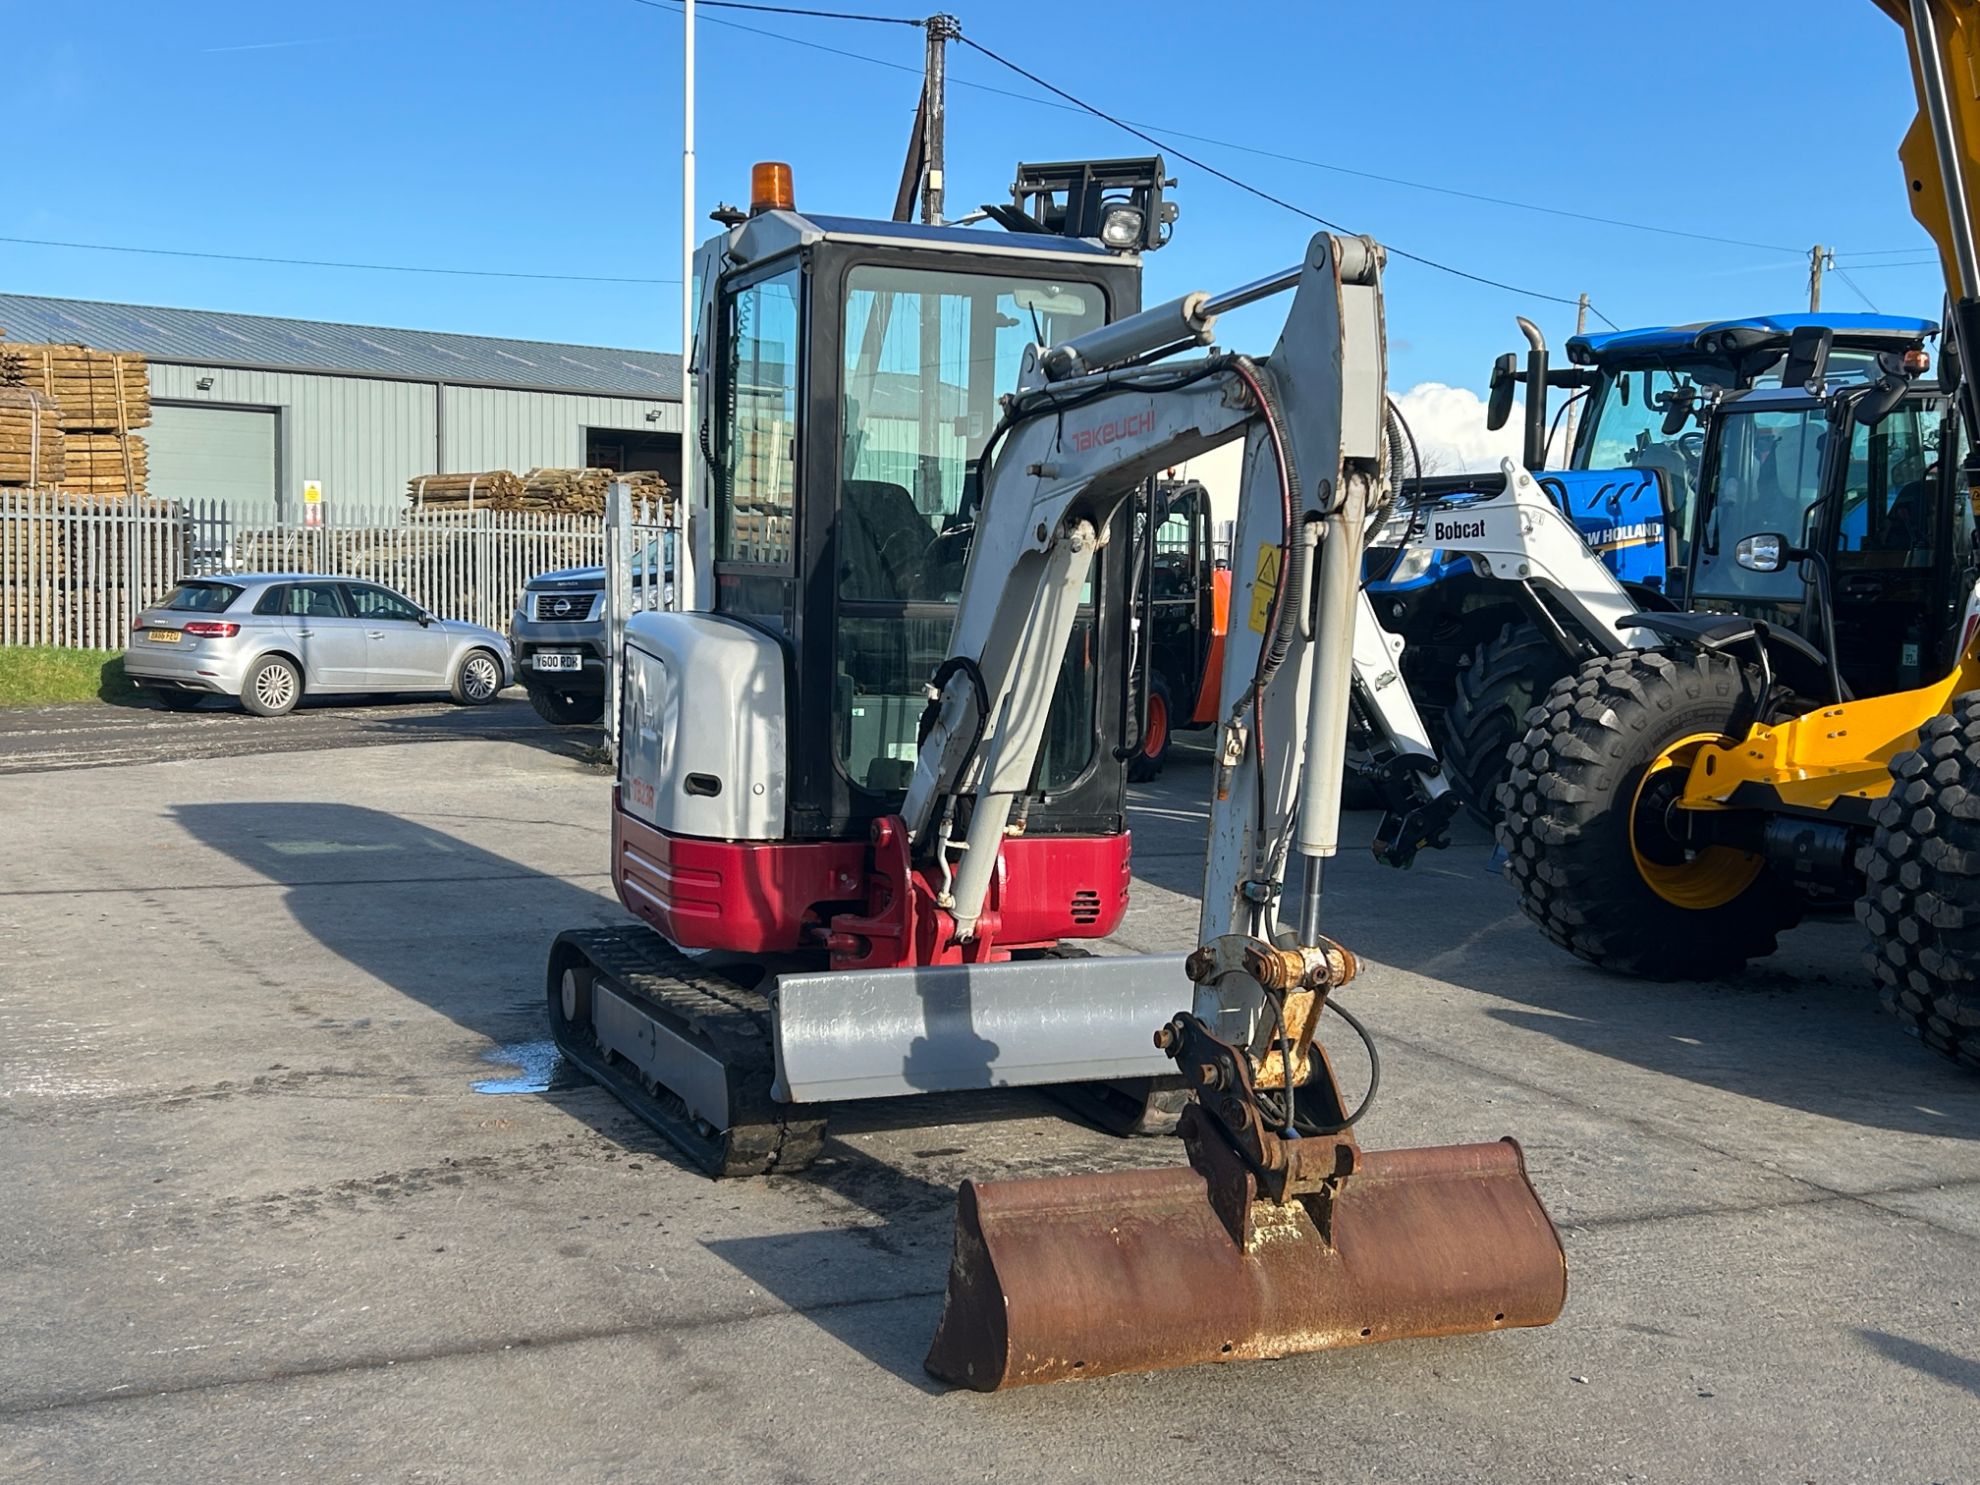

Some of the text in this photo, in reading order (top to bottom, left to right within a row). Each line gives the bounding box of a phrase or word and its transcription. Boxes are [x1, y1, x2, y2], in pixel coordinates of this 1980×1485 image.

[1072, 410, 1155, 452] TAKEUCHI
[1435, 519, 1485, 541] Bobcat
[1603, 523, 1661, 543] HOLLAND
[536, 655, 559, 668] Y600
